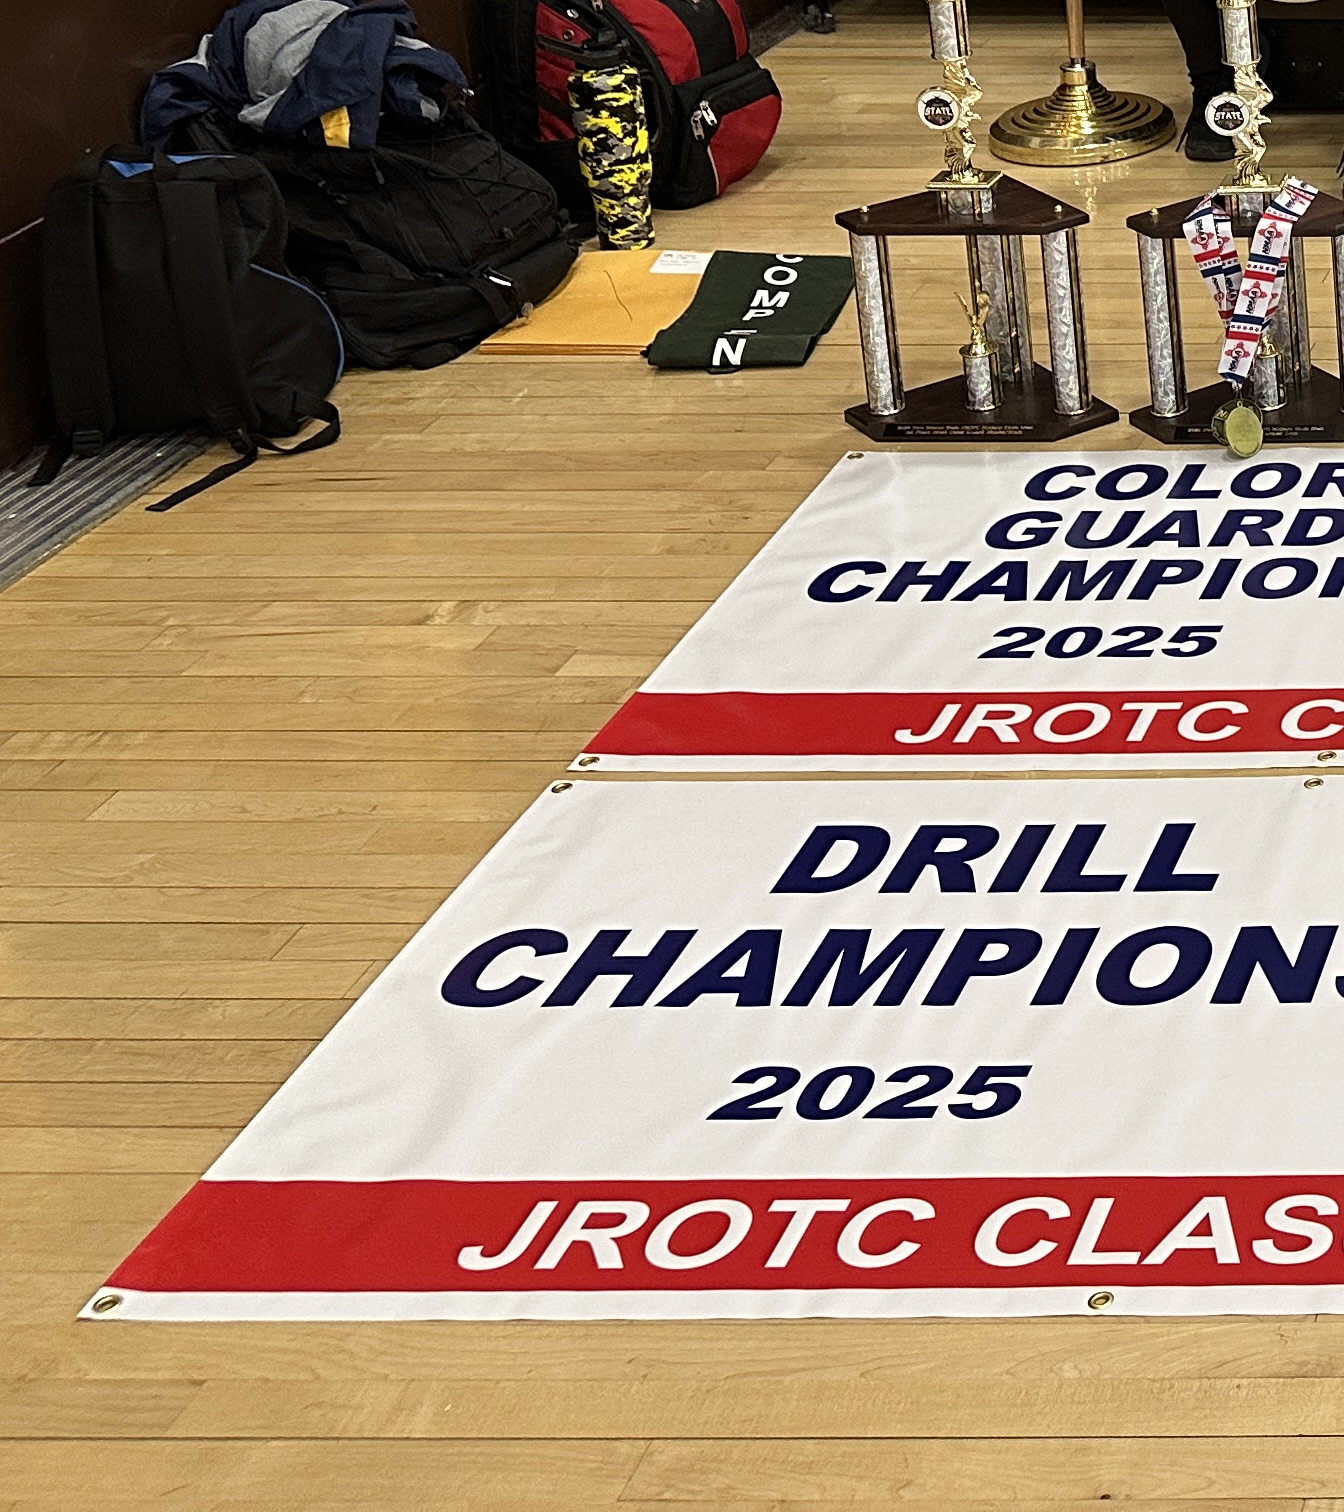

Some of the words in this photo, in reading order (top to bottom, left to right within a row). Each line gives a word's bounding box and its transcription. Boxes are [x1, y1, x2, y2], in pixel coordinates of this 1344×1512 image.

[925, 107, 951, 116] STATE
[1215, 112, 1243, 121] STATE
[977, 625, 1223, 659] 2025
[894, 701, 1248, 744] JROTC
[770, 823, 1216, 894] DRILL
[706, 1064, 1032, 1121] 2025
[456, 1197, 935, 1272] JROTC
